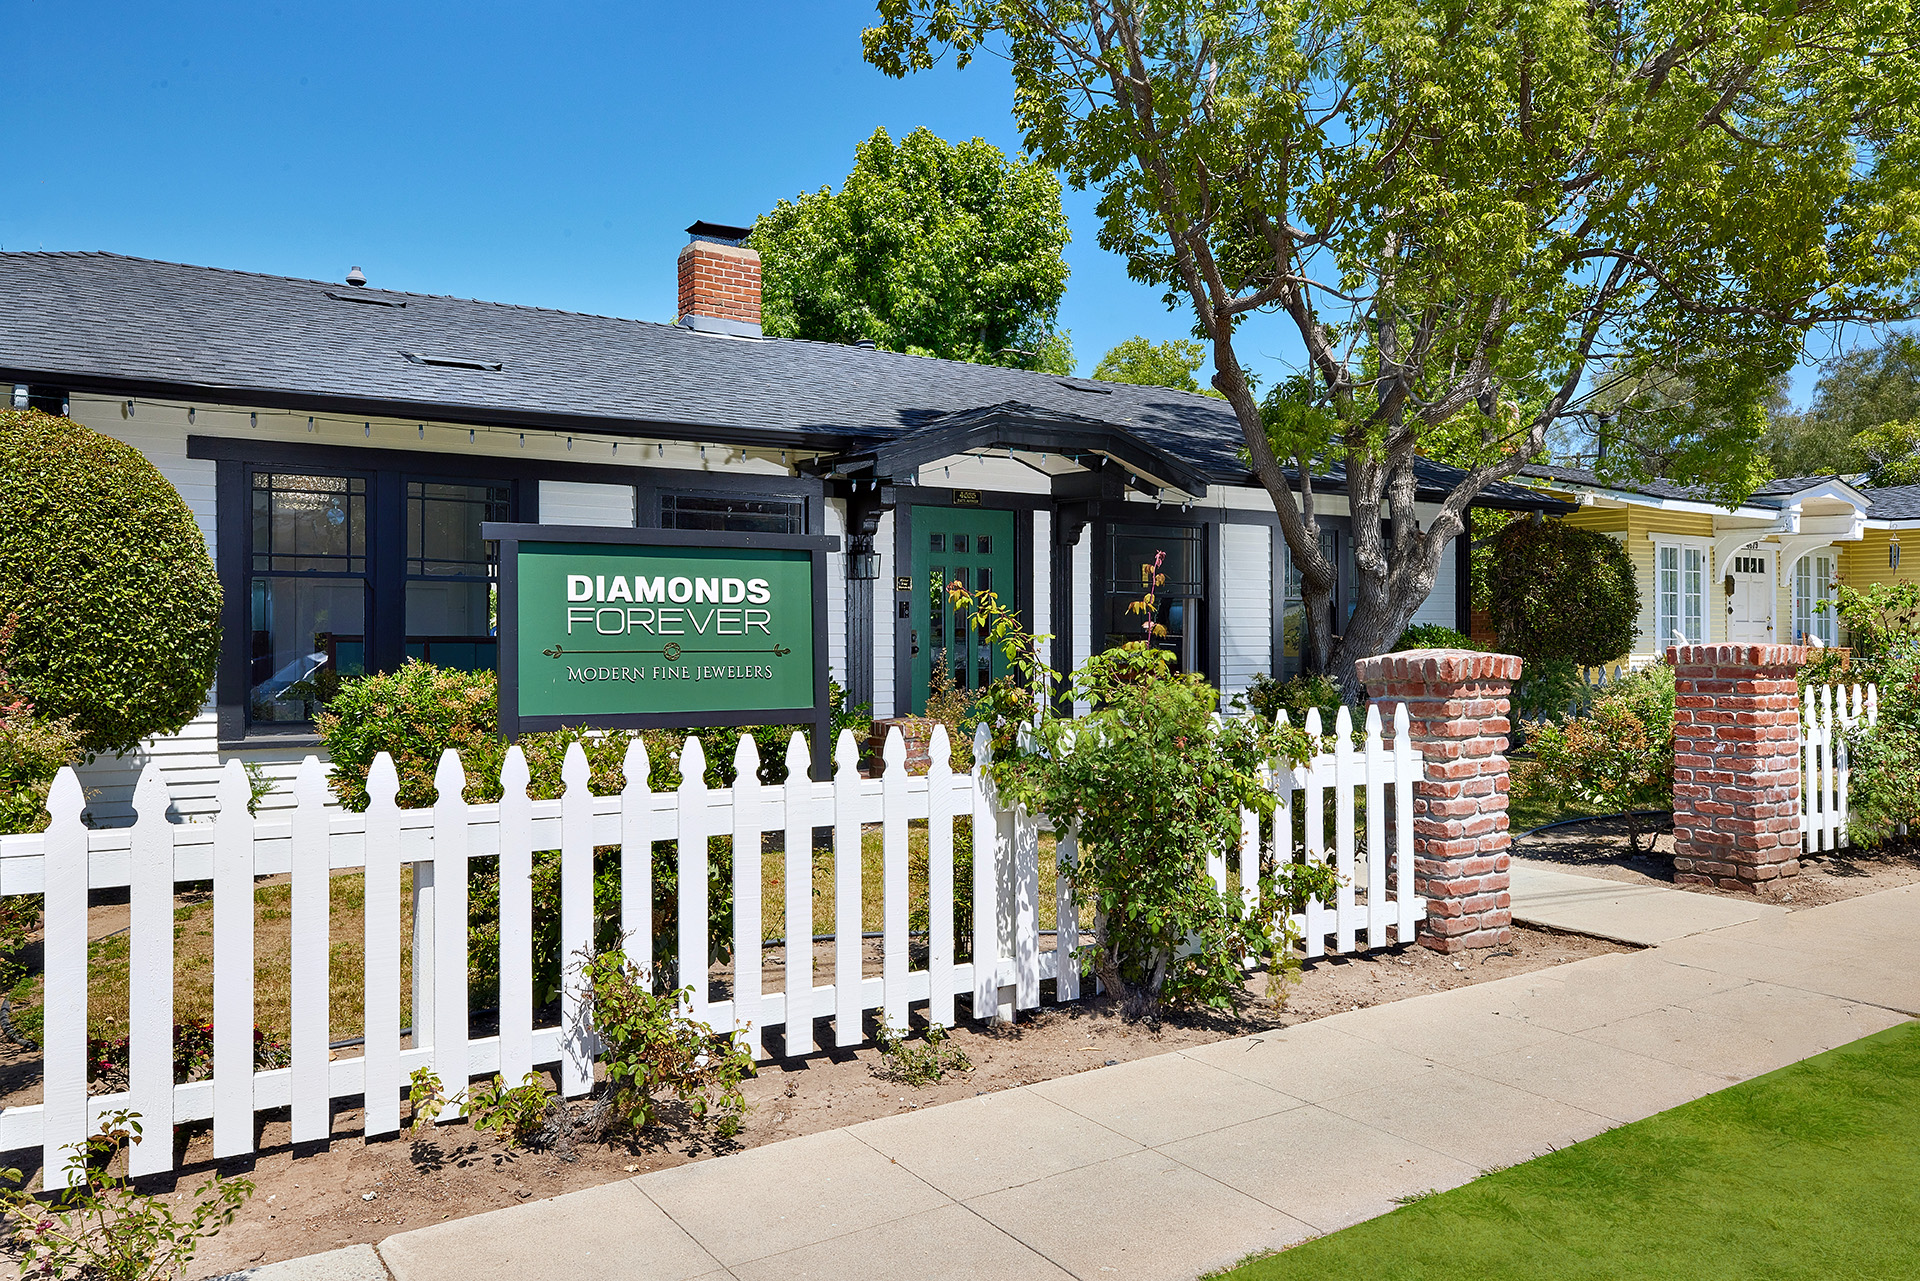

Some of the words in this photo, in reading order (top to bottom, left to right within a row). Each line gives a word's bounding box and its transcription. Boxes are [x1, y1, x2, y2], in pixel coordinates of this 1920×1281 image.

[568, 575, 770, 603] DIAMONDS
[568, 608, 770, 634] FOREVER
[567, 666, 644, 682] MODERN
[653, 667, 690, 678] FINE
[697, 666, 772, 680] JEWELERS
